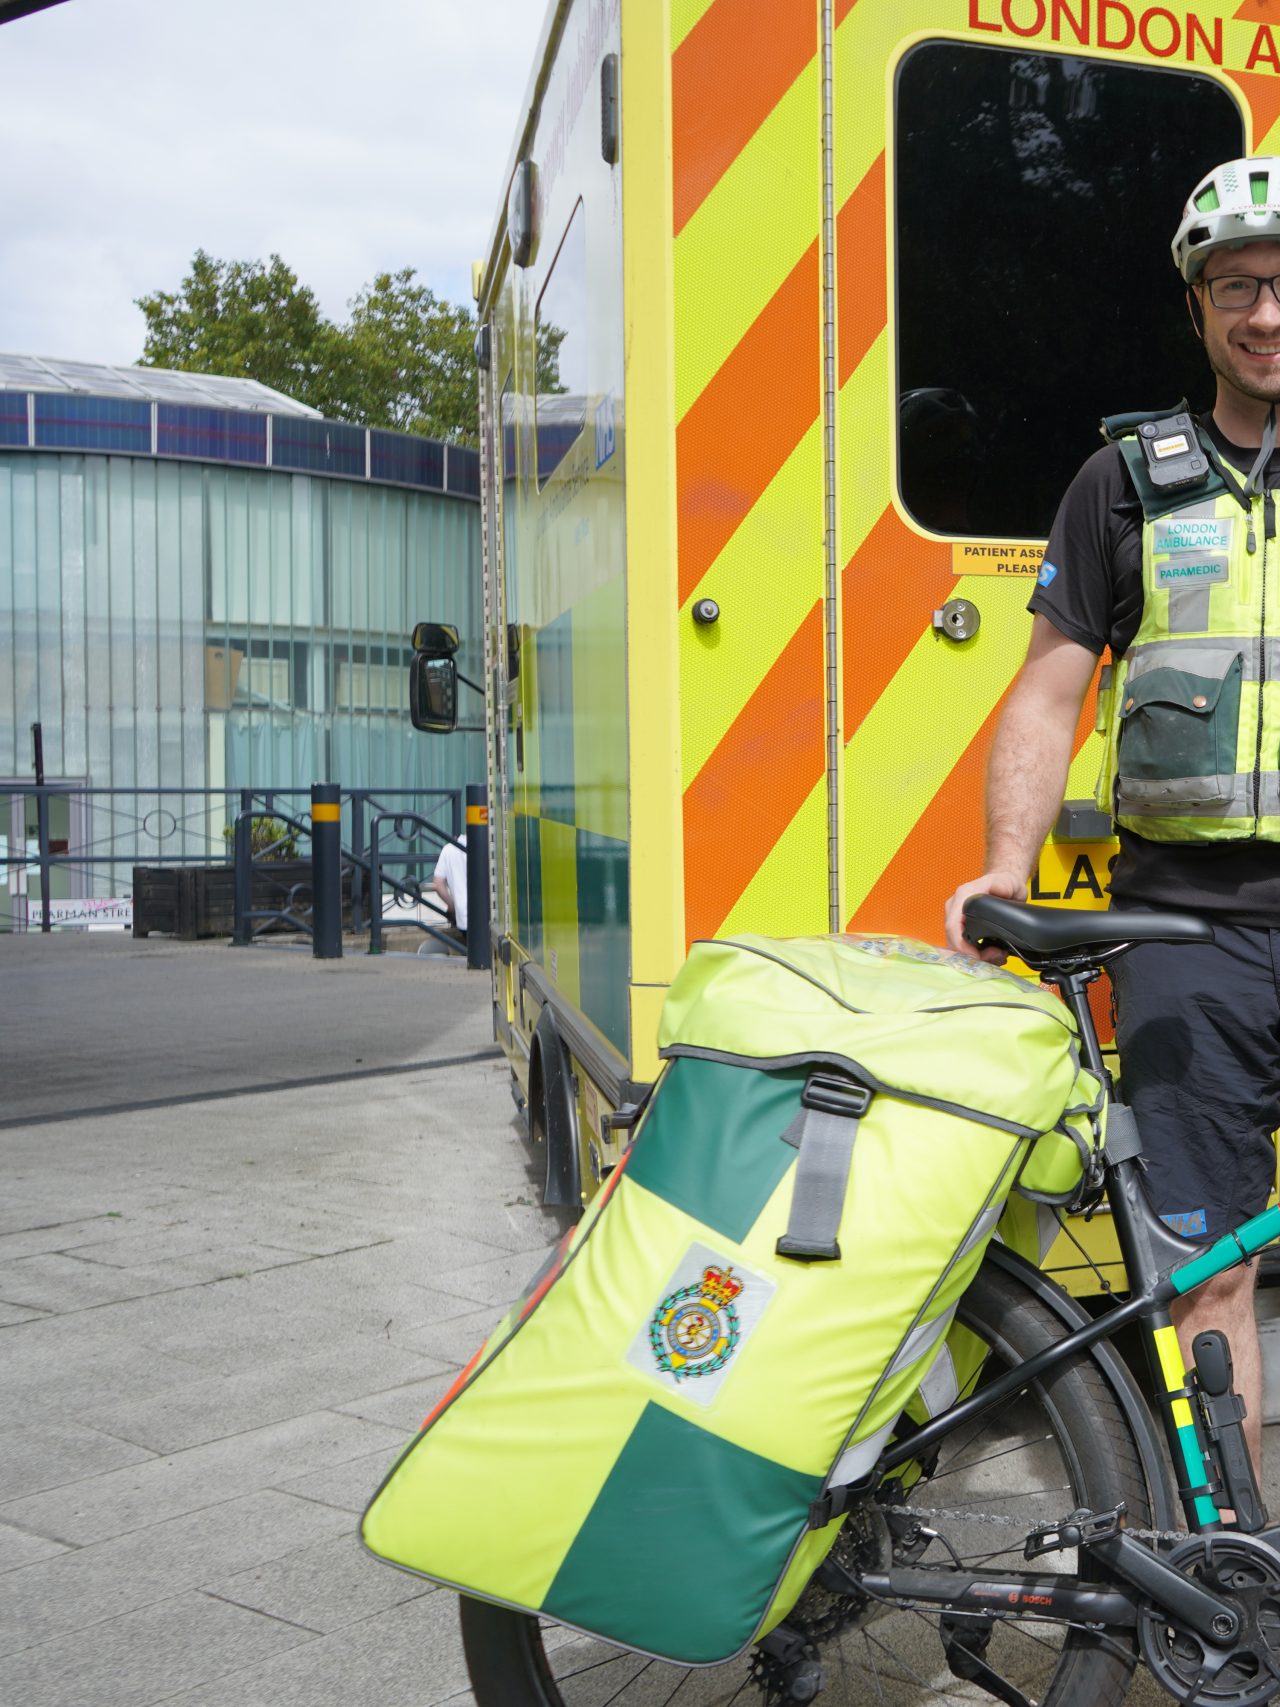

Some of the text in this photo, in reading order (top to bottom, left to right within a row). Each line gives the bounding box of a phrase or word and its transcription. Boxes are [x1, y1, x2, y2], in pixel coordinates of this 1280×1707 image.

[968, 0, 1223, 65] LONDON
[1167, 523, 1217, 535] LONDON
[1157, 535, 1228, 548] AMBULANCE
[964, 546, 1046, 558] PATIENT ASS
[1160, 564, 1221, 579] PARAMEDIC
[32, 907, 130, 919] PARMAN STRE
[1023, 1595, 1051, 1606] BOSCH
